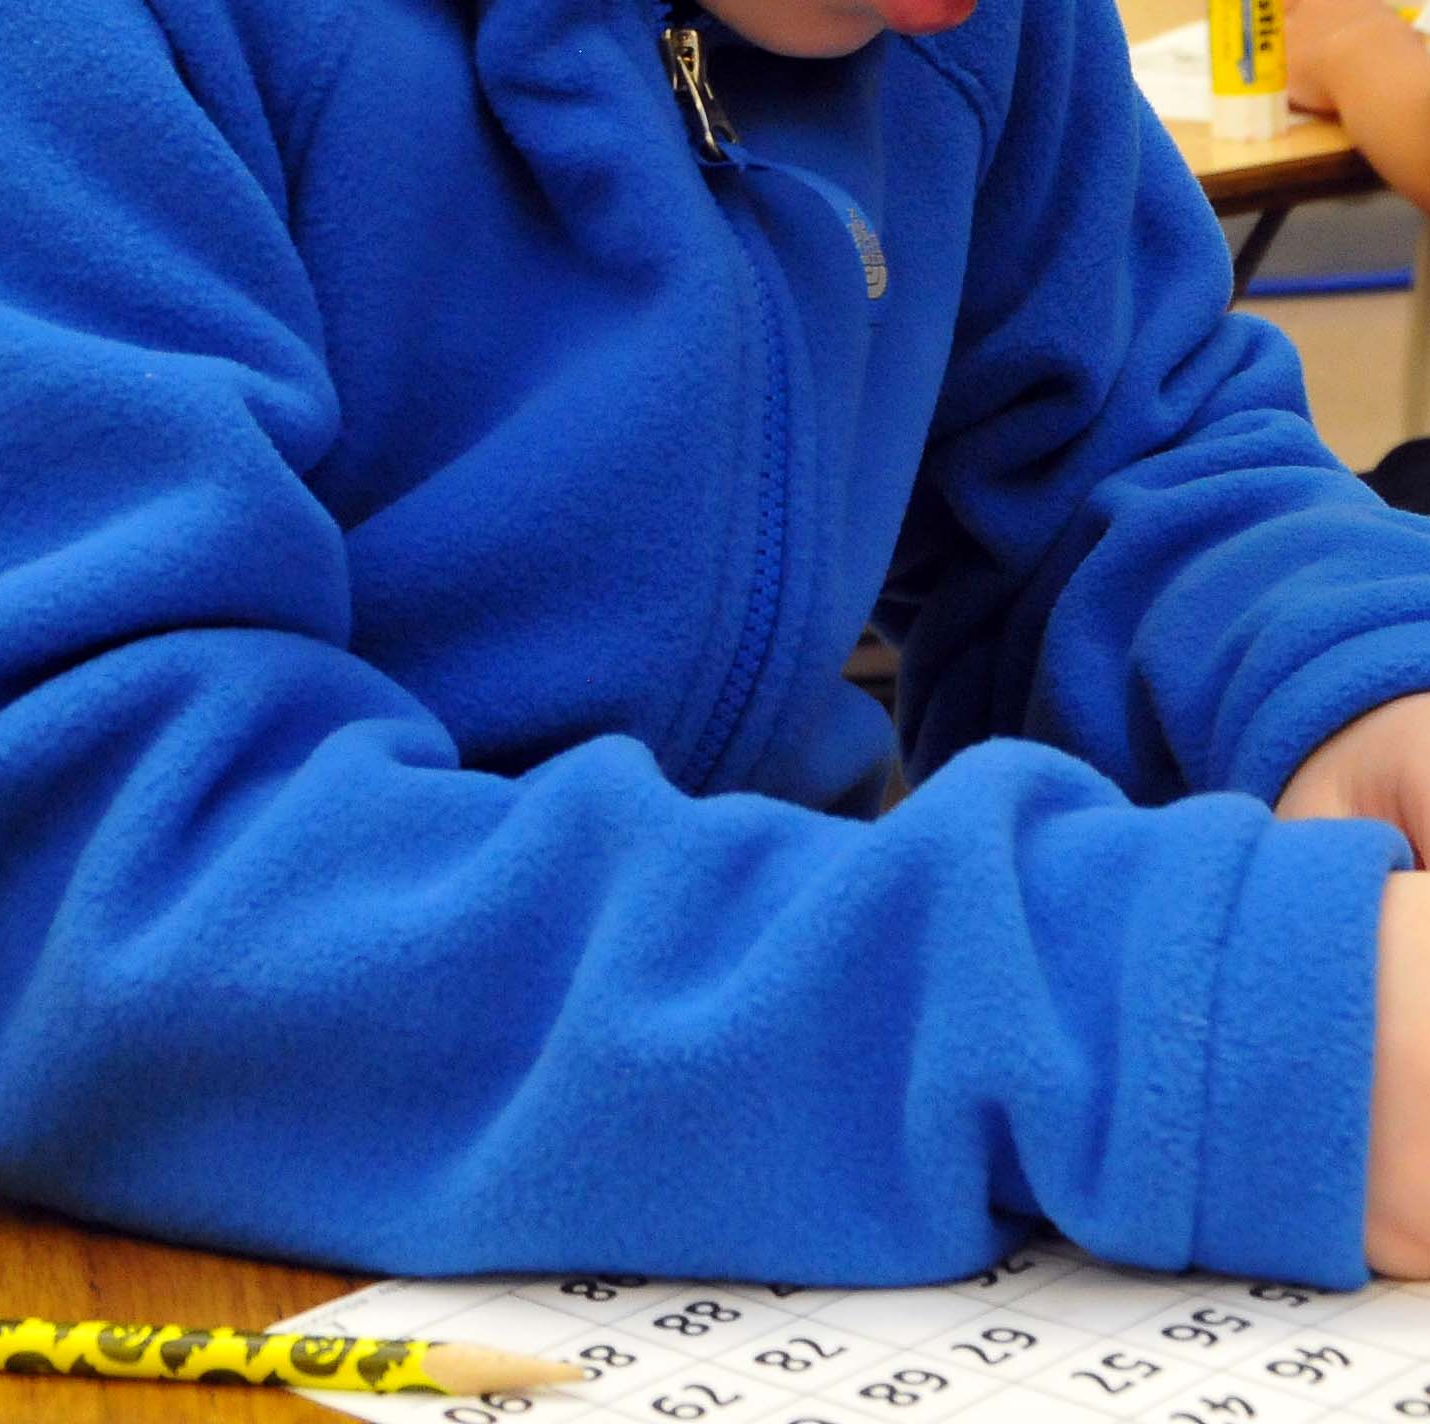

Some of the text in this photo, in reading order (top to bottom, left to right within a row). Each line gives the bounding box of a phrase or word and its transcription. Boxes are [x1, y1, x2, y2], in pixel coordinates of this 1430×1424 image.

[652, 1300, 742, 1337] 88
[1161, 1309, 1252, 1347] 56
[754, 1337, 847, 1373] 78
[952, 1327, 1039, 1366] 67
[1265, 1346, 1351, 1384] 46
[859, 1368, 949, 1406] 68
[1072, 1352, 1161, 1395] 57
[444, 1387, 533, 1424] 90
[651, 1383, 742, 1421] 79
